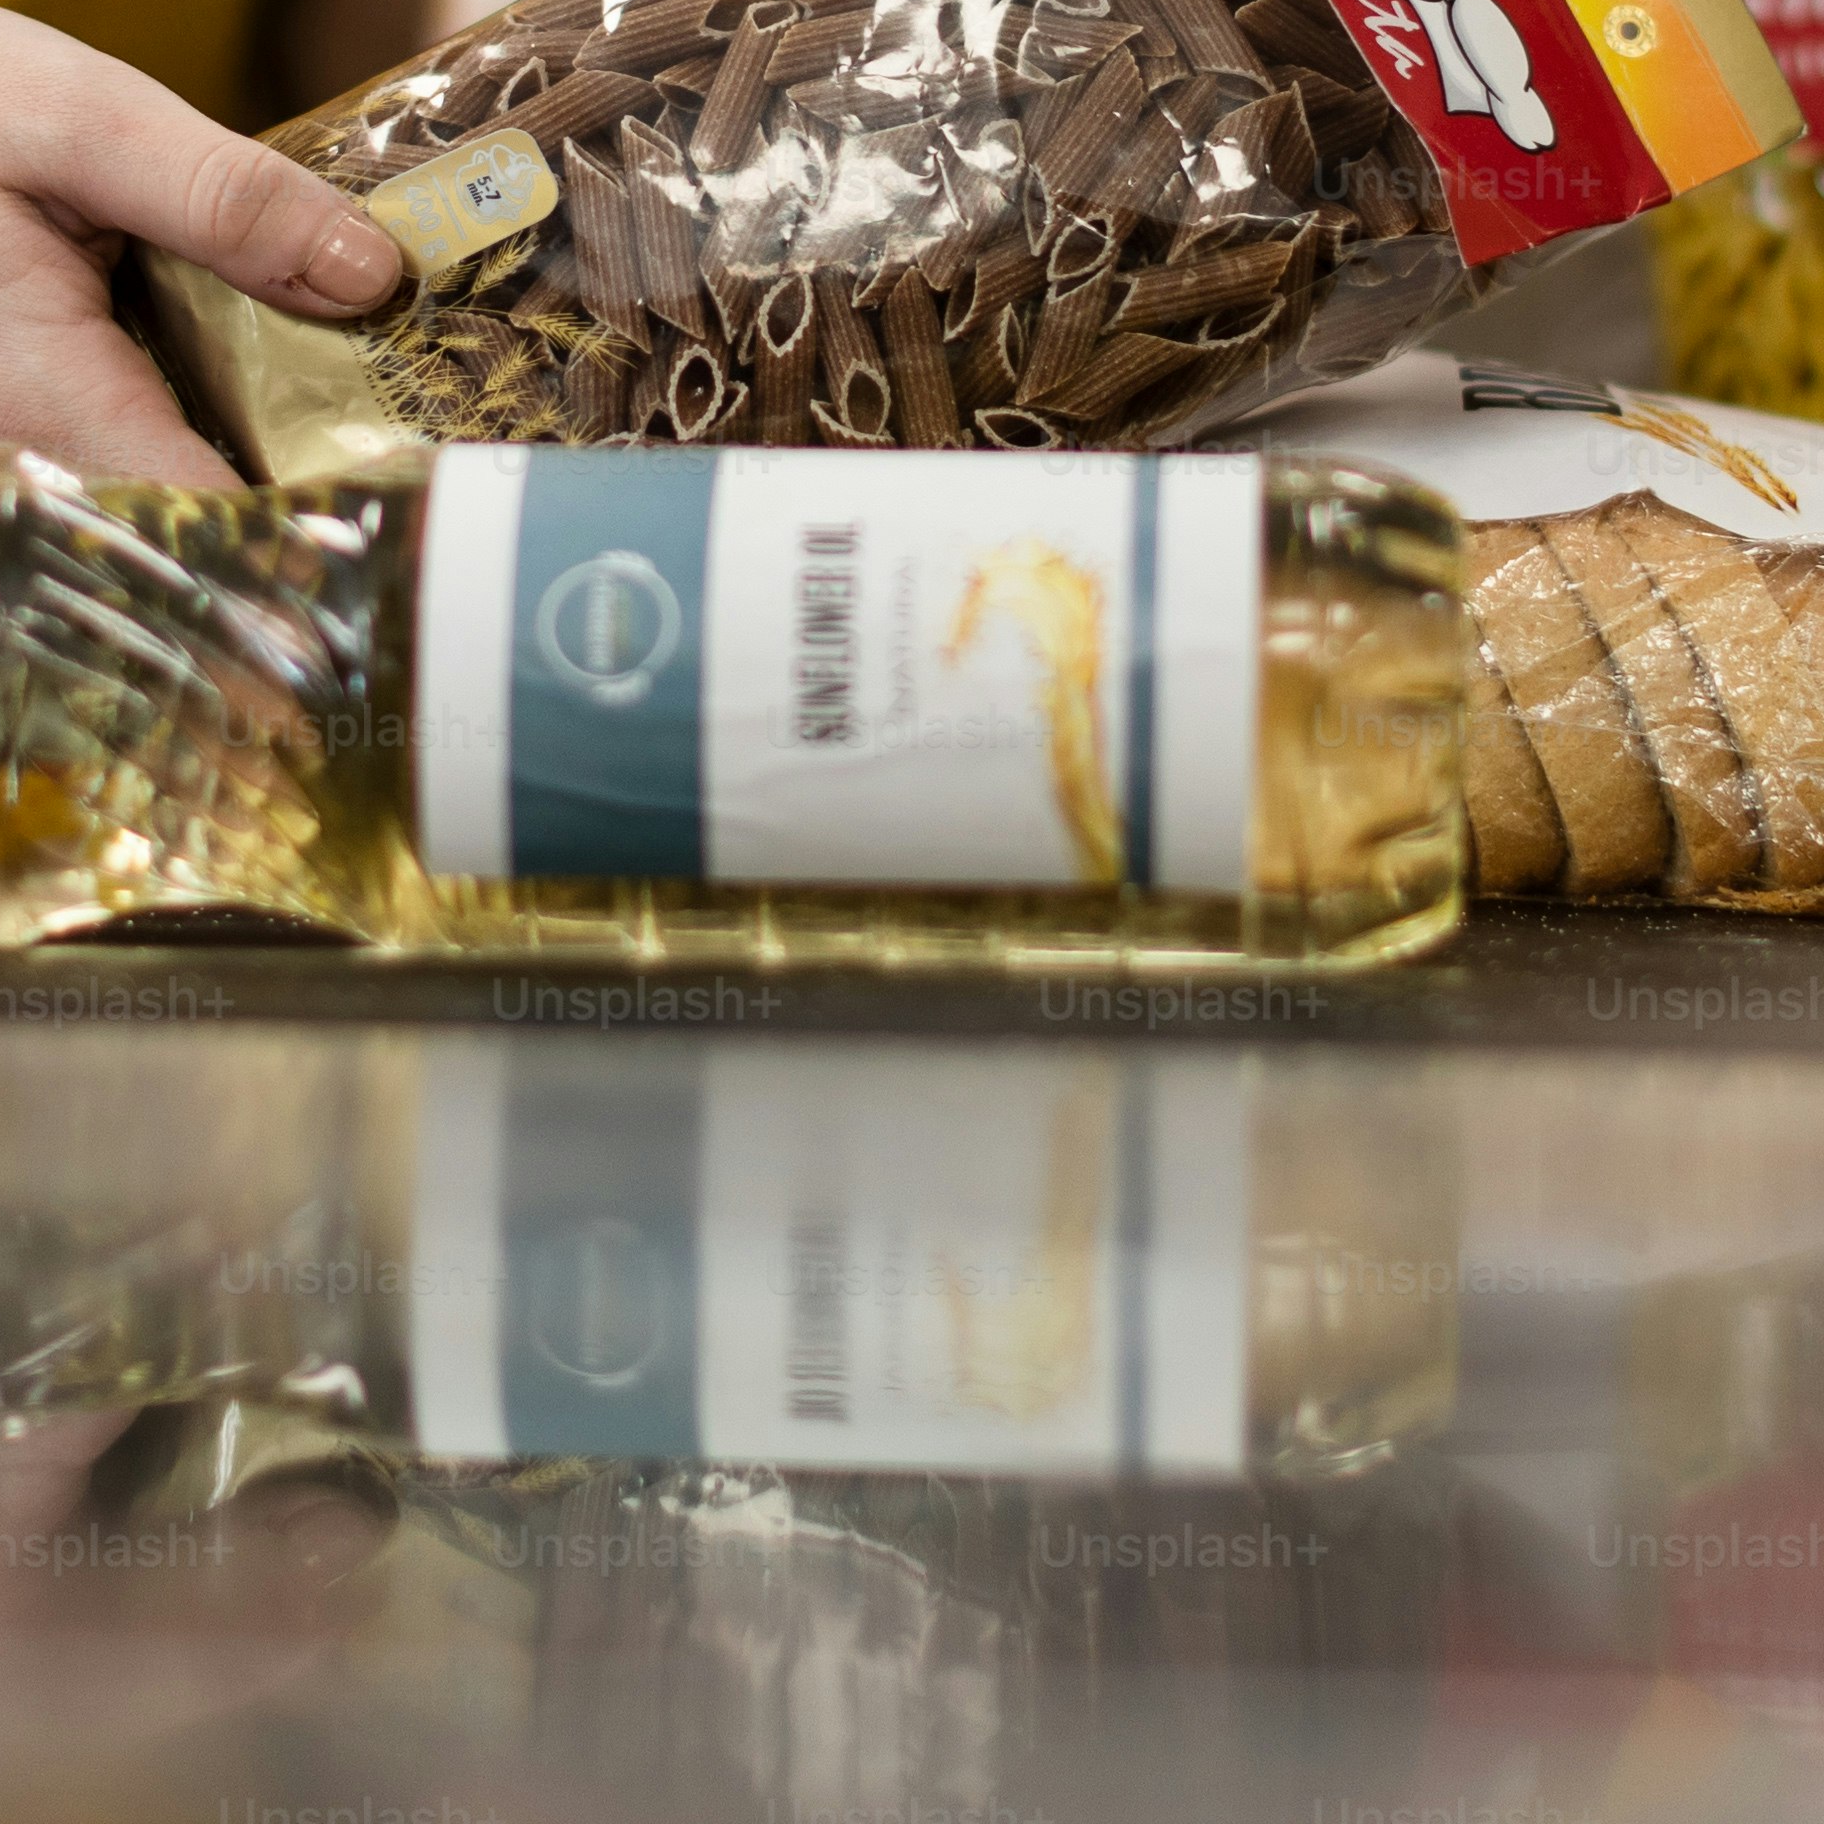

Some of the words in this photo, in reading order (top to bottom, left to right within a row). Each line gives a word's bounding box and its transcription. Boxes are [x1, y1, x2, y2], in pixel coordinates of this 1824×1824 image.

[466, 182, 483, 207] min.
[477, 176, 502, 199] 5-7
[405, 185, 442, 232] 400
[800, 520, 860, 556] OIL
[795, 564, 857, 742] SUNFLOWER
